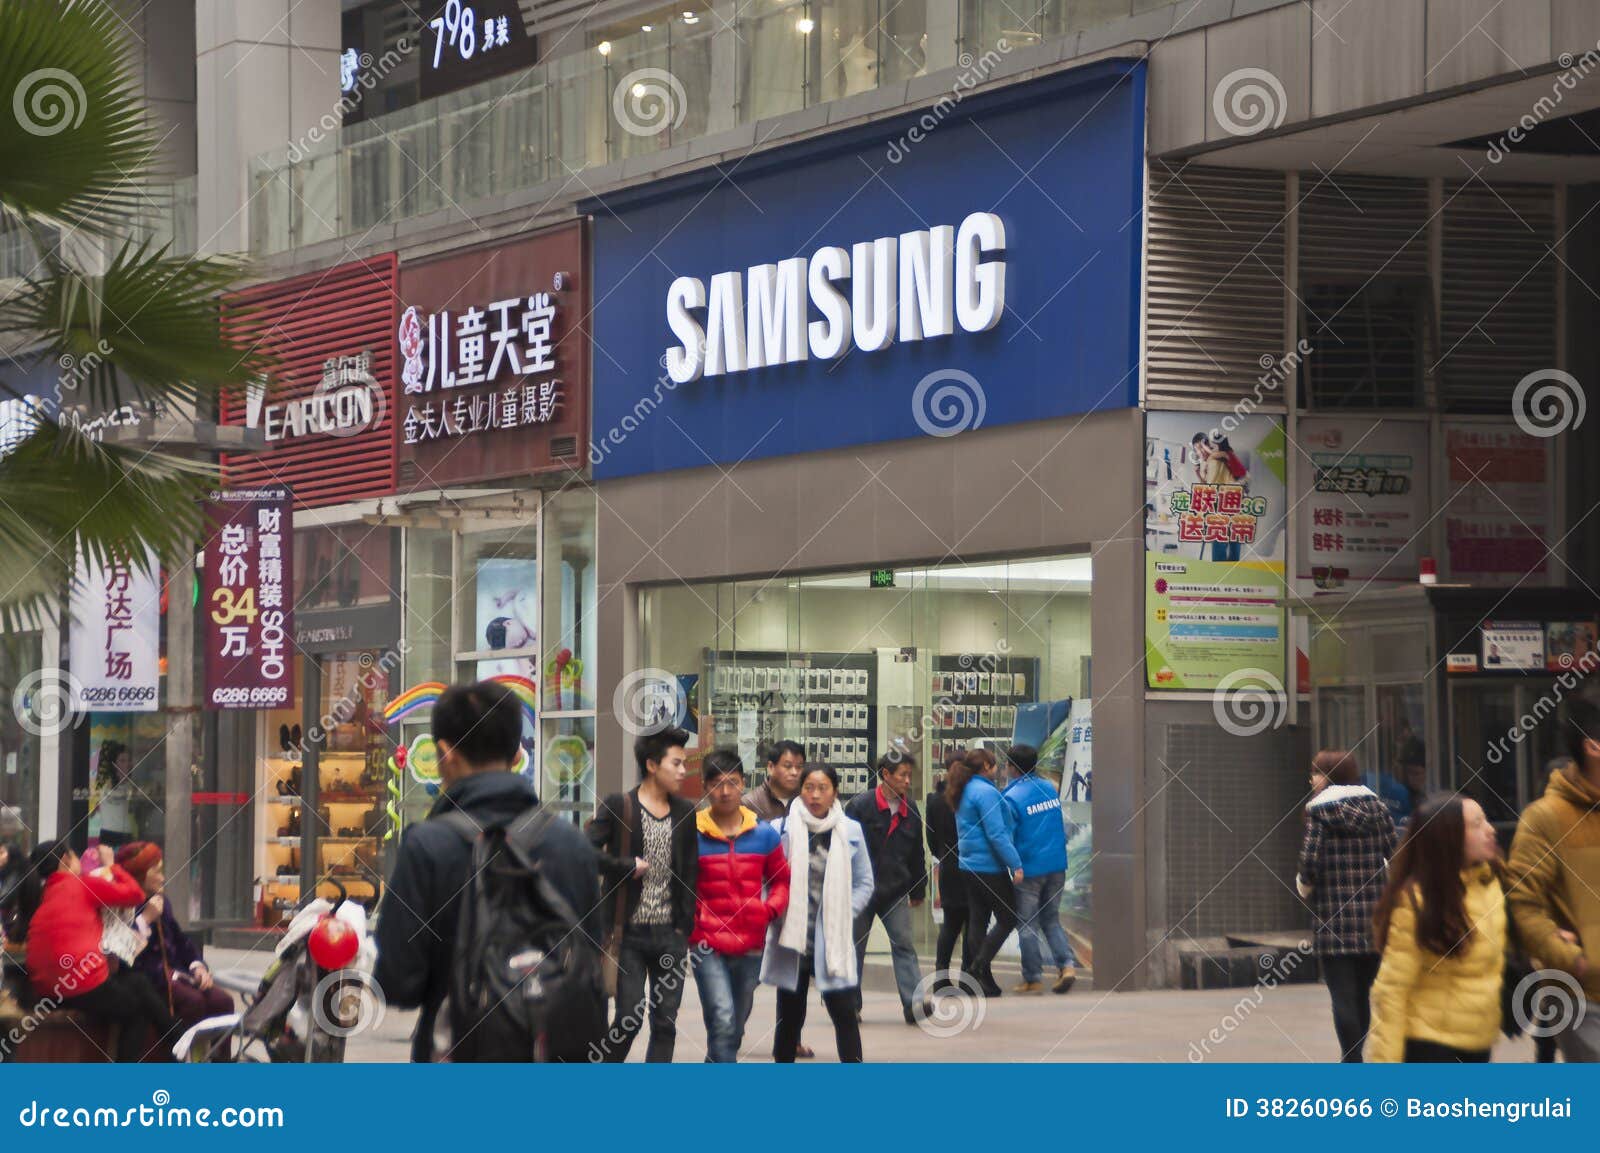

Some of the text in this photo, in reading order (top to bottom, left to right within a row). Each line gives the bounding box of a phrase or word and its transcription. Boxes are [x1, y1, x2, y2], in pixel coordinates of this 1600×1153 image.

[430, 0, 475, 69] 798
[666, 212, 1006, 383] SAMSUNG
[425, 292, 555, 392] 儿童天堂
[403, 379, 557, 444] 金夫人专业儿童摄影
[1179, 514, 1257, 542] 送宽带
[118, 687, 155, 701] 6666
[250, 687, 288, 702] 6666
[1026, 798, 1061, 815] SAMSUN
